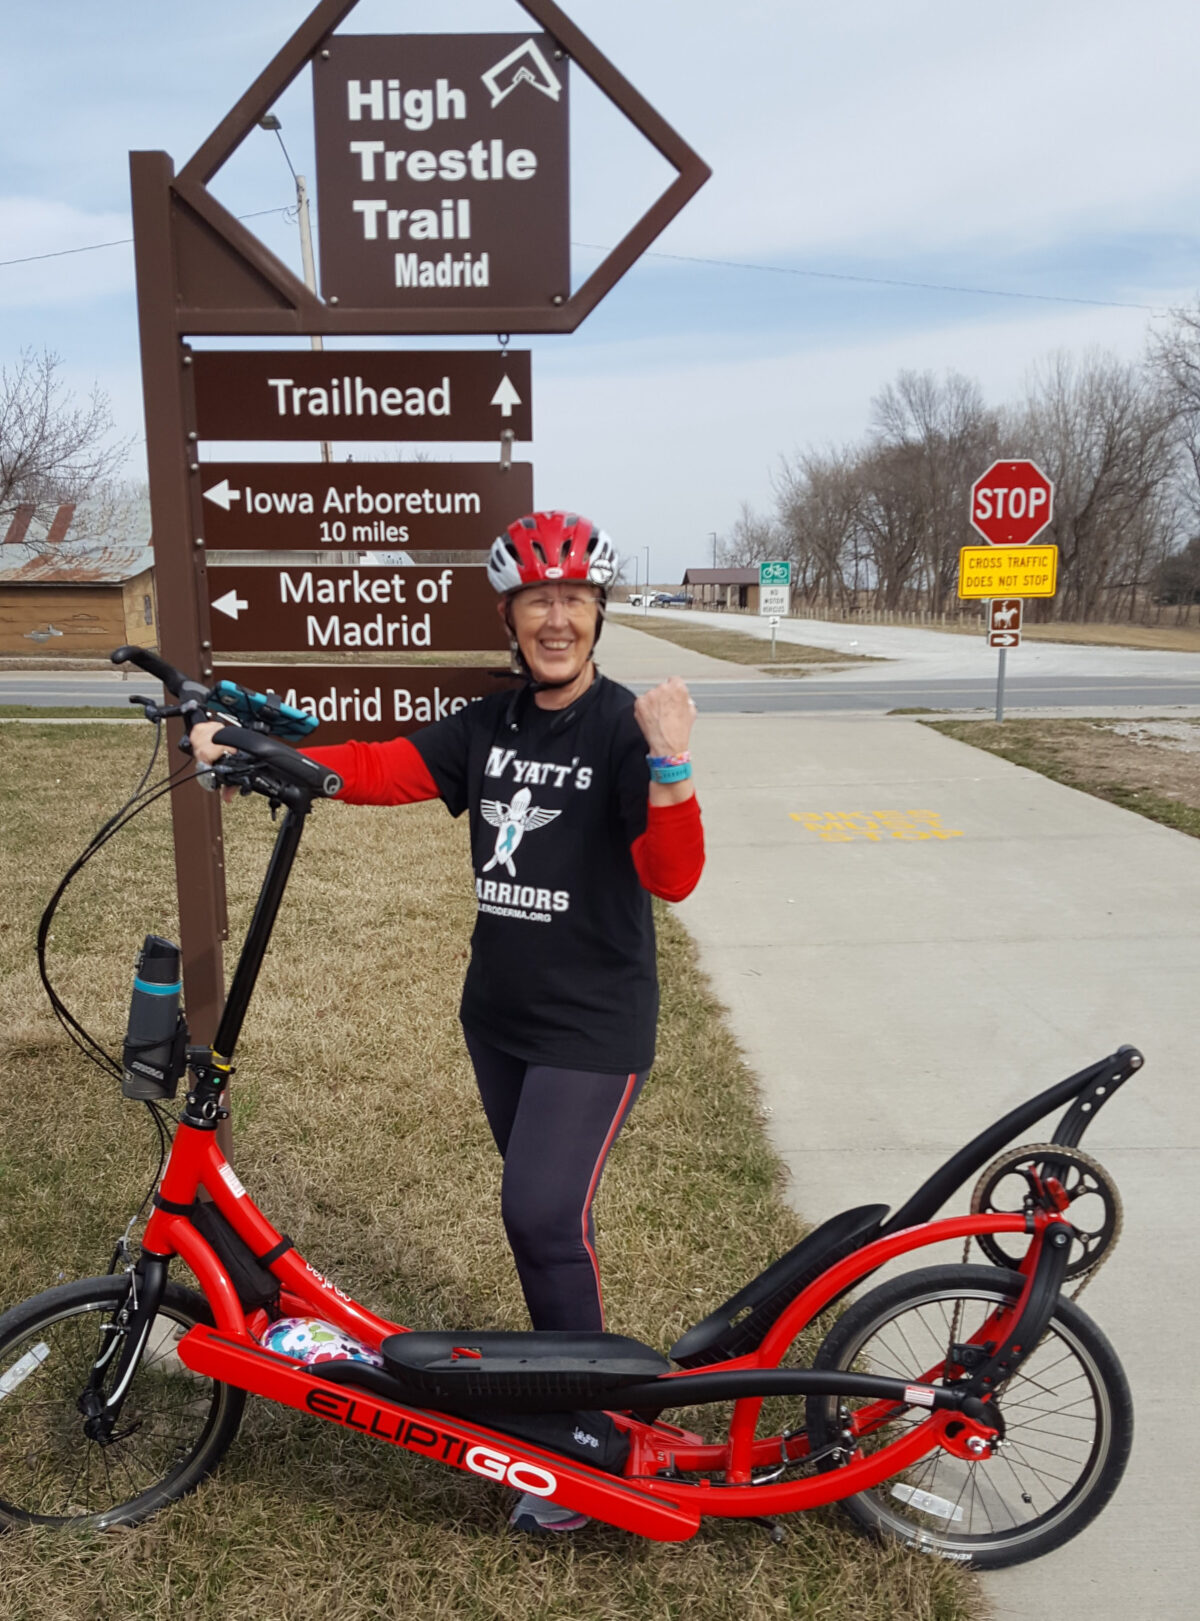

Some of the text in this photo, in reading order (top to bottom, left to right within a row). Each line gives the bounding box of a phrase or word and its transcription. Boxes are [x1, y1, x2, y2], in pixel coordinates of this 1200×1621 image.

[347, 78, 466, 131] High
[349, 139, 537, 182] Trestle
[352, 198, 471, 240] Trail
[394, 252, 489, 288] Madrid
[267, 376, 451, 416] Trailhead
[245, 485, 481, 514] Iowa Arboretum
[976, 487, 1047, 520] STOP
[319, 520, 409, 543] 10 miles
[968, 556, 1048, 569] CROSS TRAFFIC
[279, 569, 453, 604] Market of
[966, 574, 1049, 588] DOES NOT STOP
[306, 613, 431, 647] Madrid
[394, 687, 488, 722] Bake
[475, 877, 571, 912] ARRIORS
[478, 903, 552, 923] LERODERMA.ORG
[305, 1388, 557, 1497] ELLIPTIGO
